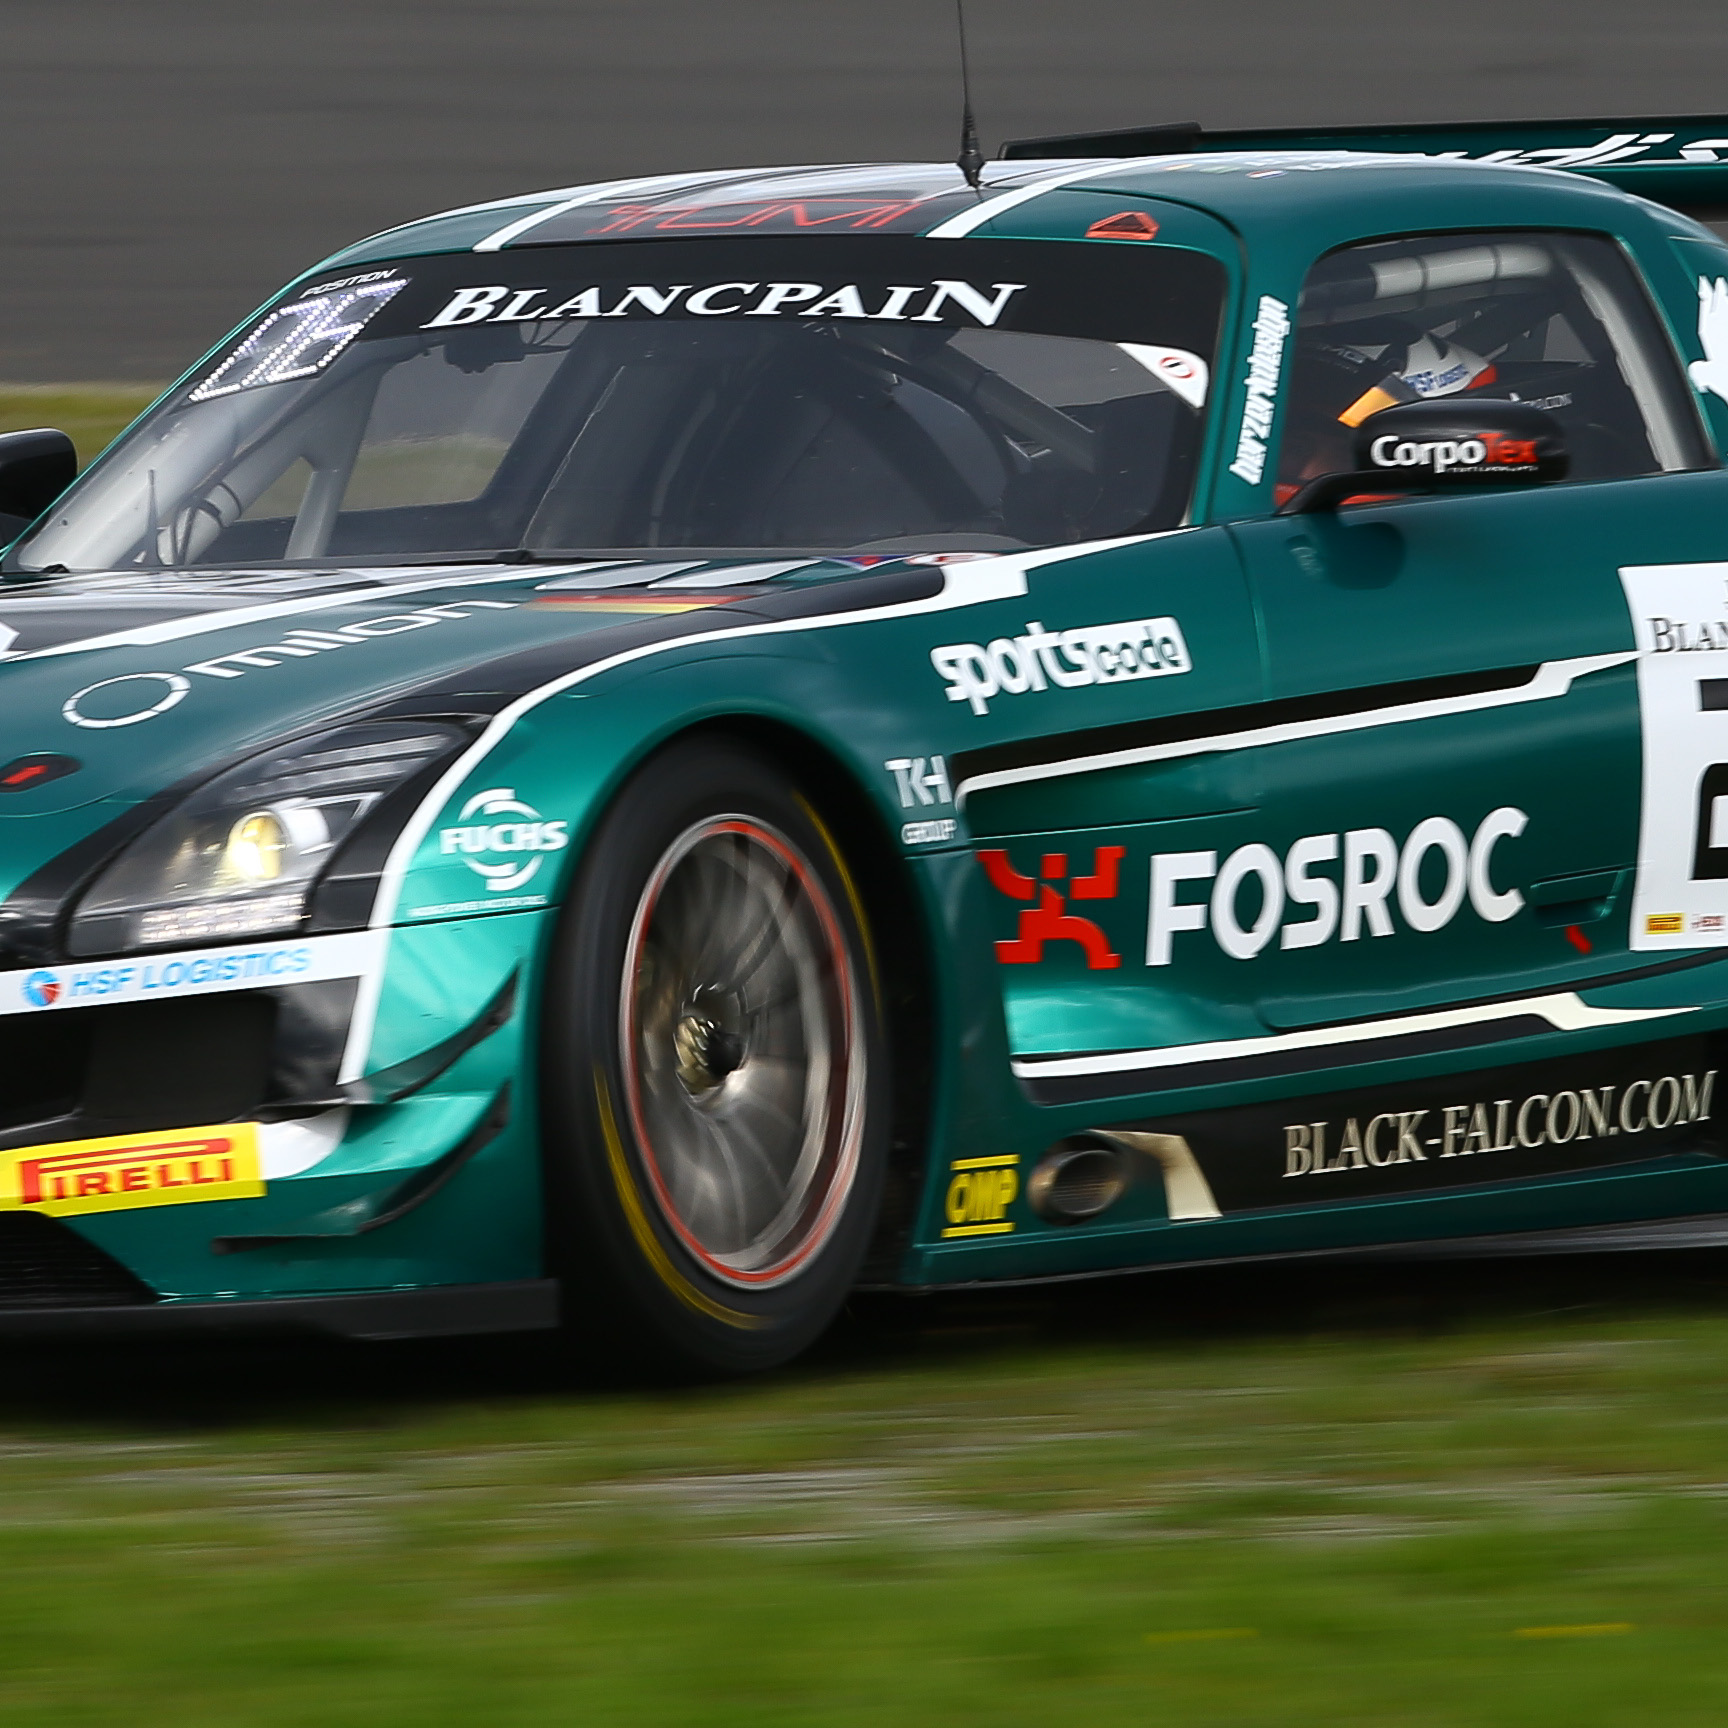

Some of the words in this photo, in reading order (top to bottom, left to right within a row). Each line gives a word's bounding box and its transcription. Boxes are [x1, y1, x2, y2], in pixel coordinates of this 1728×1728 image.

[299, 267, 399, 299] POSITION
[419, 279, 1028, 328] BLANCPAIN
[1370, 432, 1541, 474] CorpoTex
[183, 600, 521, 680] milon
[884, 755, 953, 808] TKH
[439, 820, 570, 855] FUCHS
[1144, 806, 1530, 967] FOSROC
[69, 967, 135, 997] HSF
[140, 947, 312, 990] LOGISTICS
[1281, 1069, 1719, 1177] BLACK-FALCON.COM
[19, 1137, 233, 1205] PIRELLI
[945, 1168, 1019, 1224] OMP
